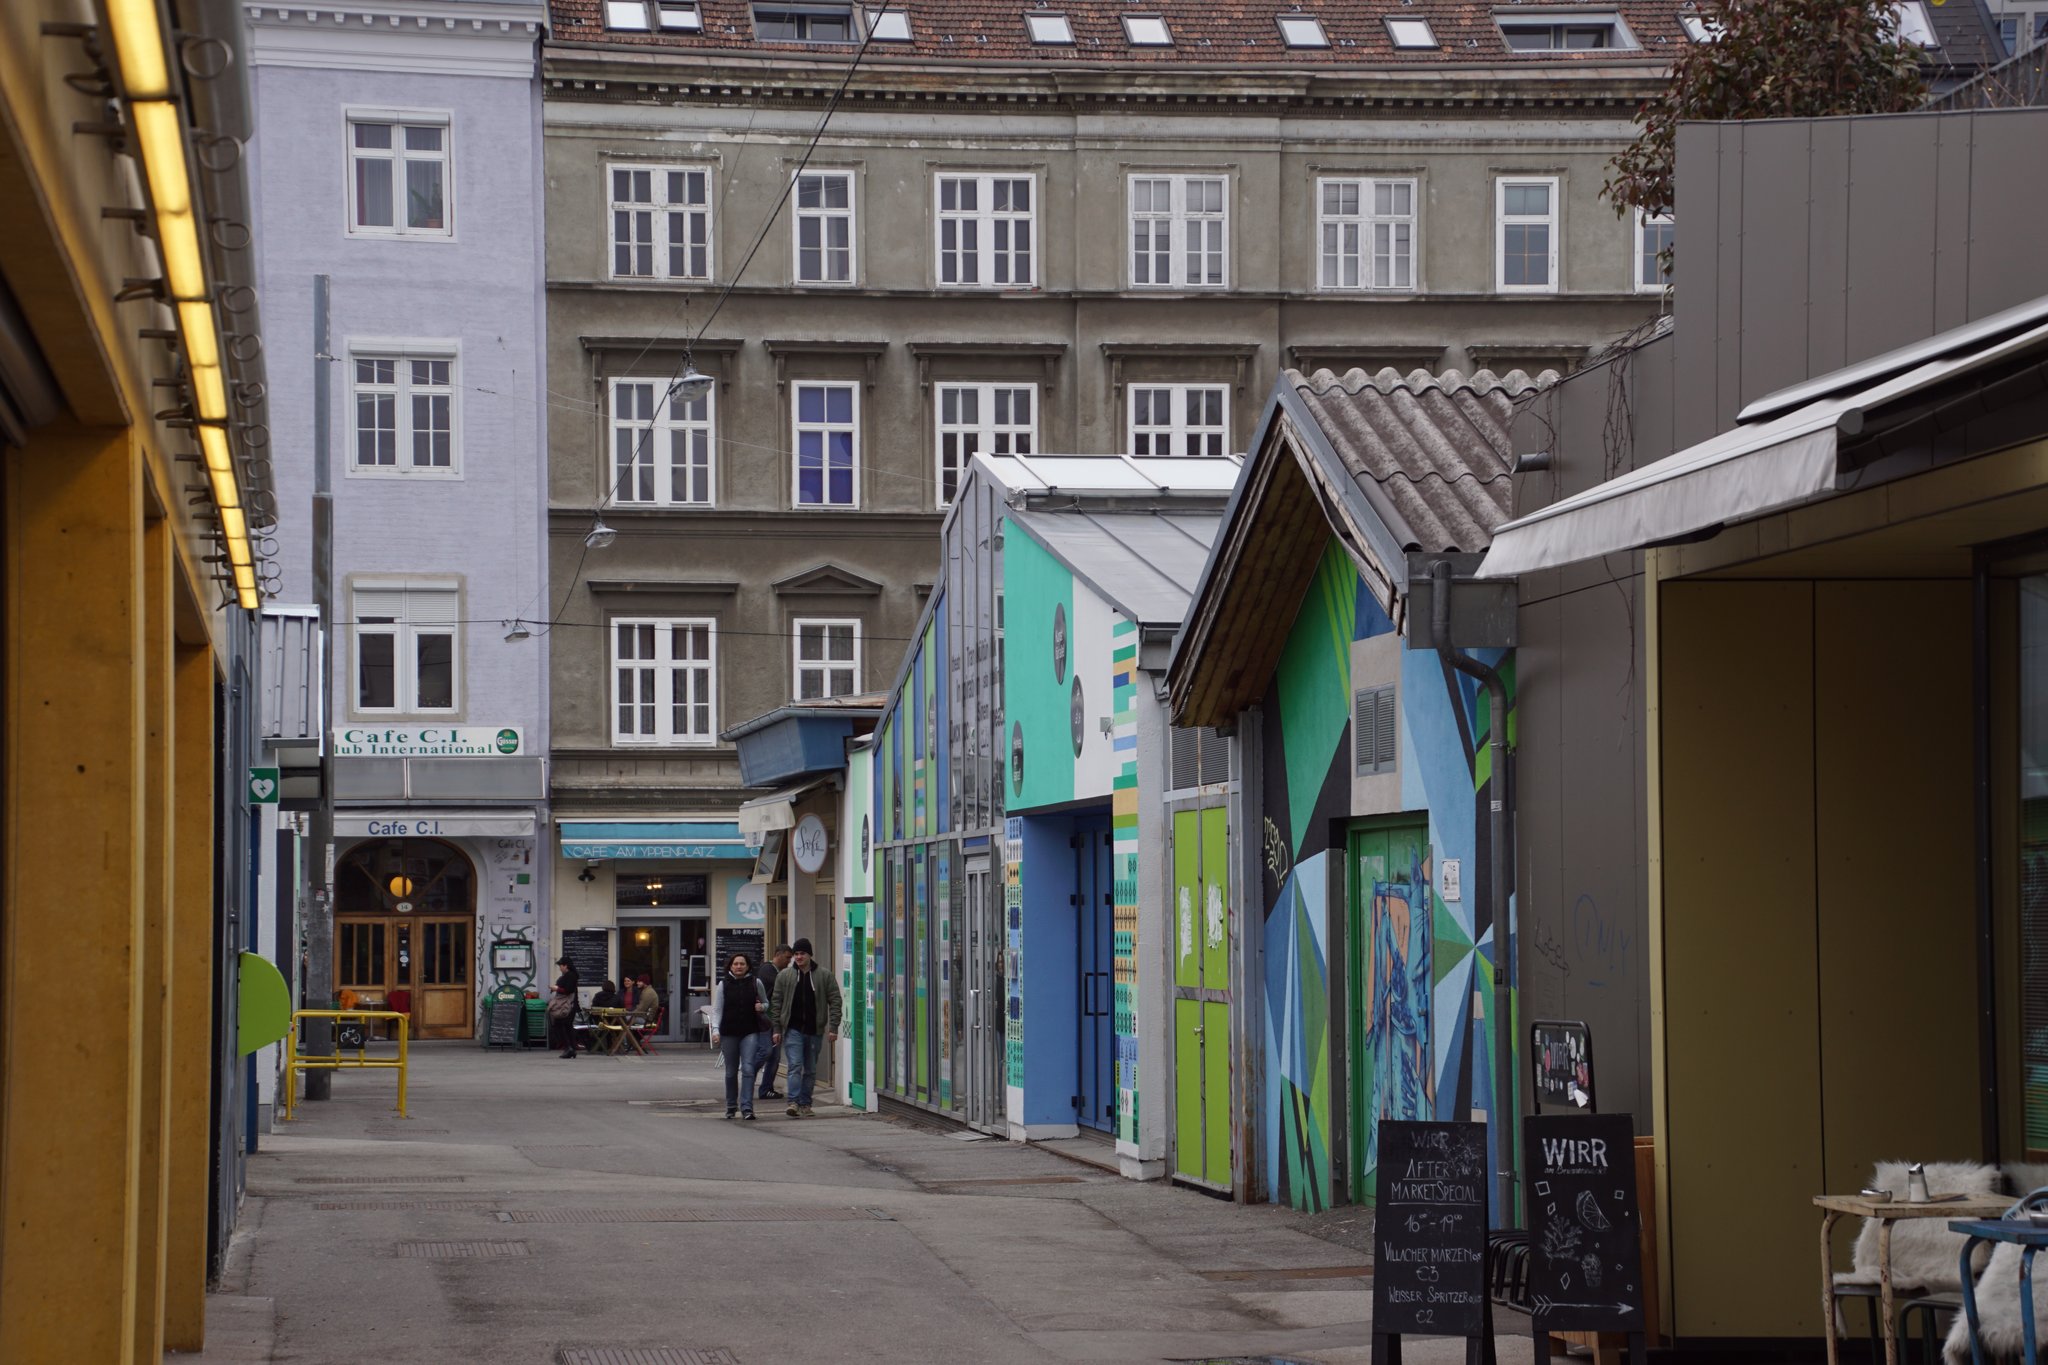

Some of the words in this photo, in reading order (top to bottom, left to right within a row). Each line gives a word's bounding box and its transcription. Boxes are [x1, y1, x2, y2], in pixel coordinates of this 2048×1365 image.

[345, 729, 408, 743] Cafe
[419, 729, 467, 743] C.I.
[335, 744, 362, 754] lub
[372, 744, 492, 754] International
[368, 821, 407, 835] Cafe
[416, 821, 443, 835] C.I.
[616, 846, 636, 857] AM
[640, 846, 716, 857] YPPENPLATZ
[1541, 1138, 1608, 1167] WIRR
[1405, 1158, 1450, 1178] AFTER
[1384, 1240, 1428, 1263] VILLACHER
[1427, 1286, 1468, 1303] SPRITZER
